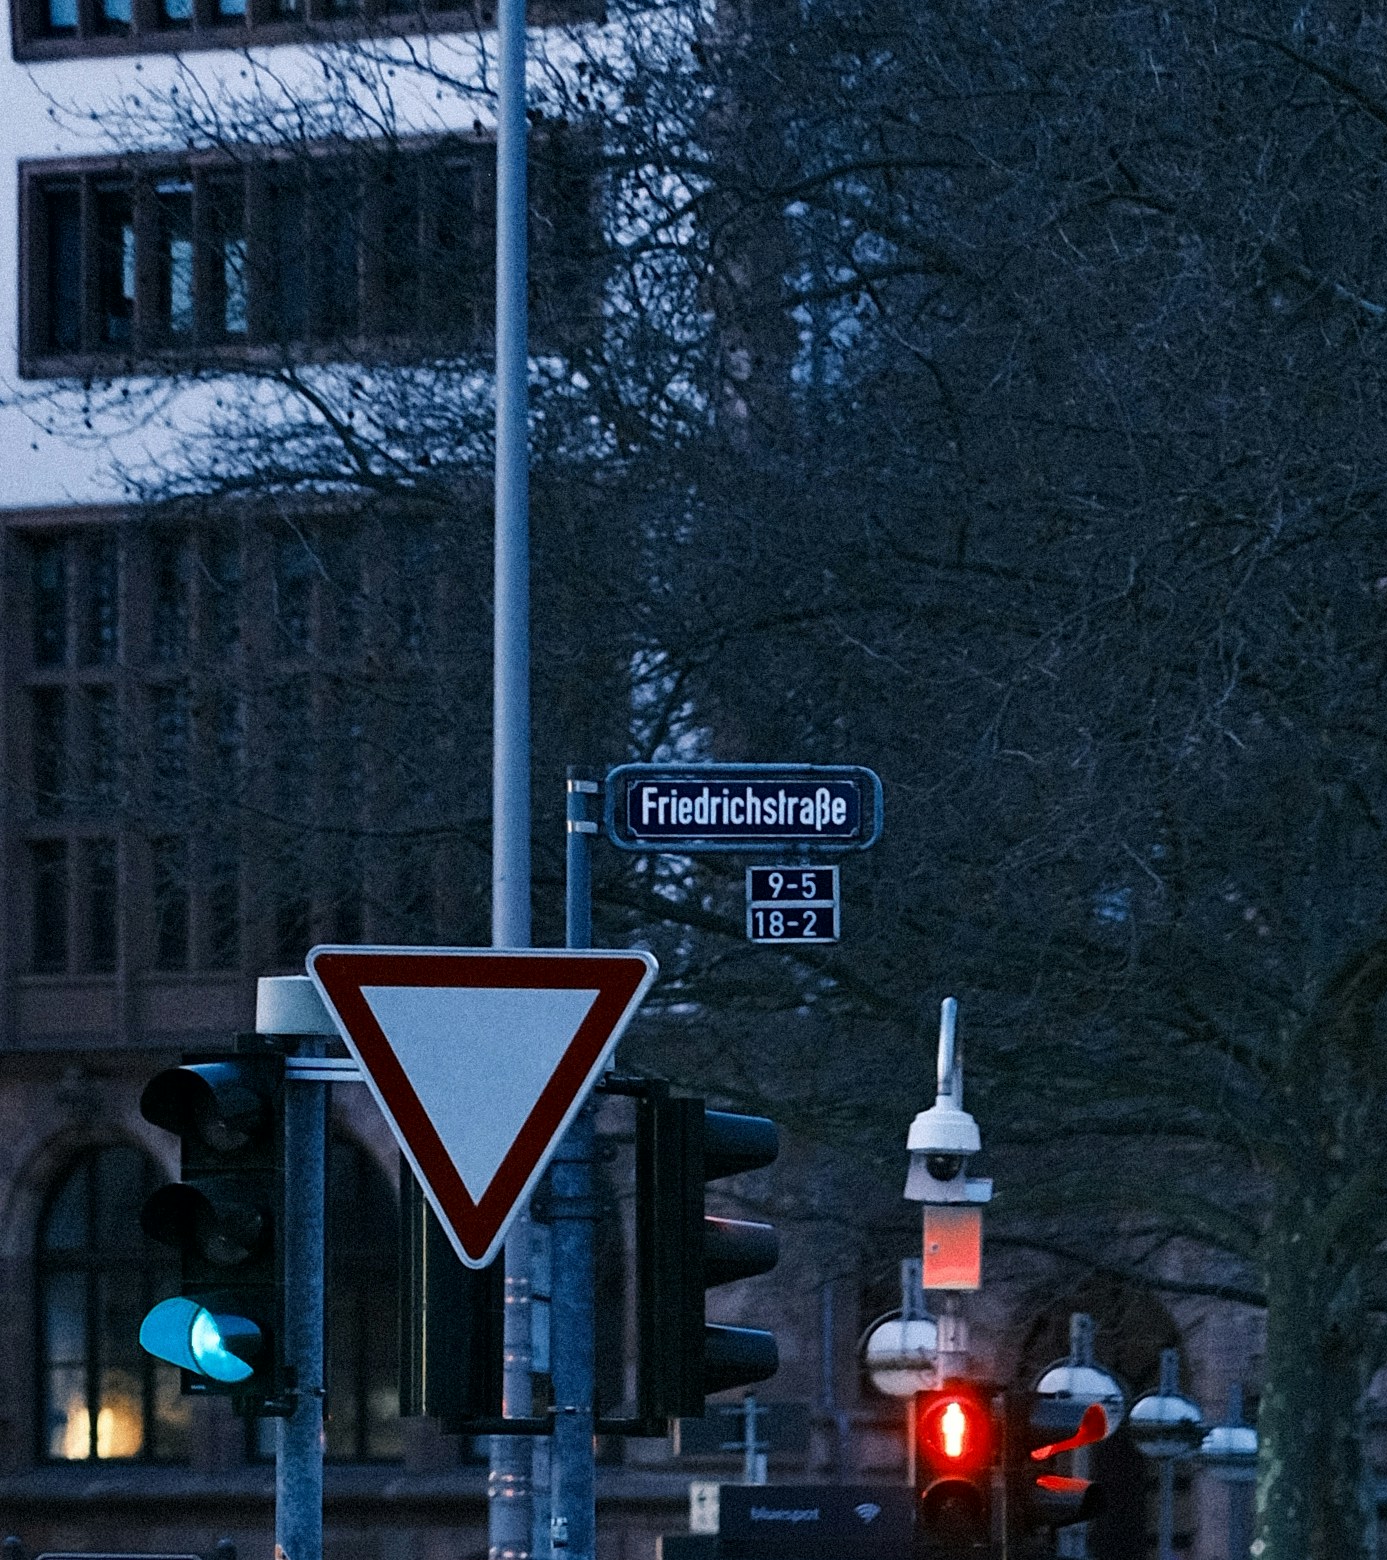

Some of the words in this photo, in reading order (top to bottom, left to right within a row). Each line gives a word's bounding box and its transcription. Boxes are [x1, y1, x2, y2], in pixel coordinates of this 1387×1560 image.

[641, 786, 847, 832] Friedrichstraße
[768, 872, 817, 899] 9-5
[754, 910, 817, 937] 18-2
